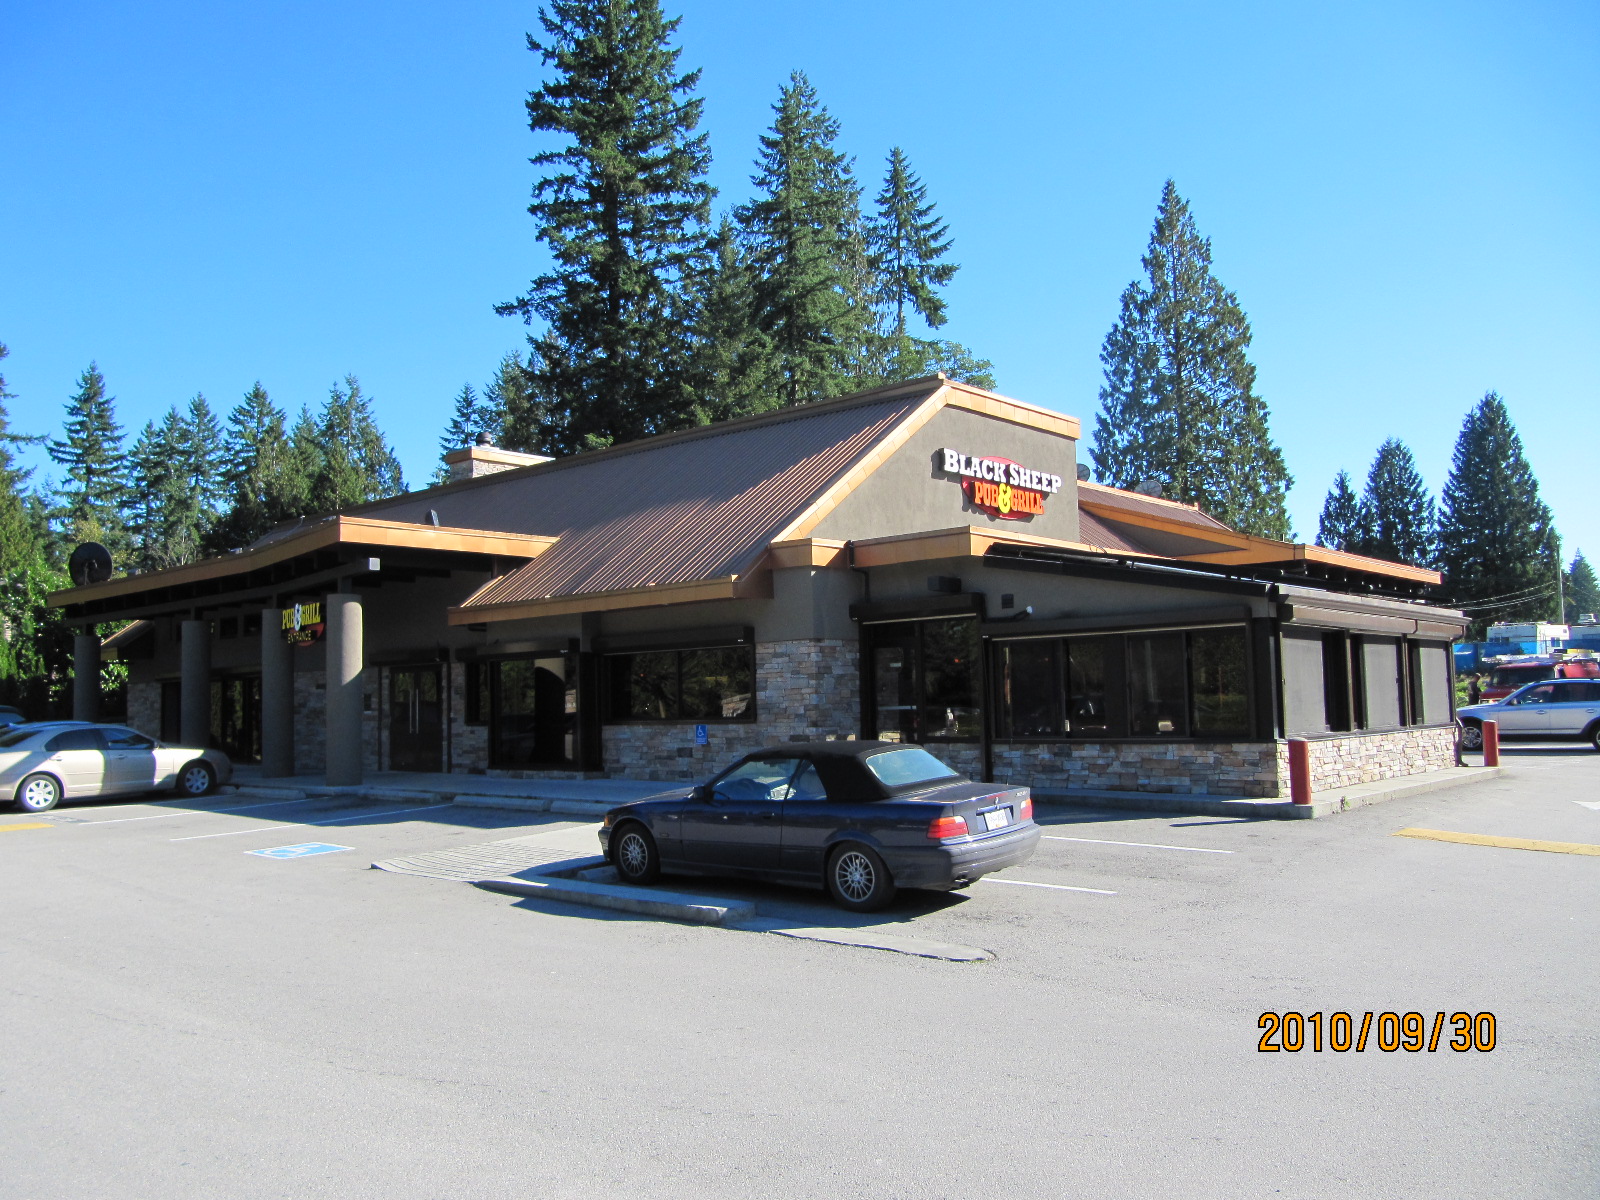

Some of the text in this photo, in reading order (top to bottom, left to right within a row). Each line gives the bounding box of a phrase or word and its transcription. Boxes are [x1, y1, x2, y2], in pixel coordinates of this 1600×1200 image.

[943, 448, 1061, 494] BLACK SHEEP
[974, 481, 999, 507] PUB
[1010, 488, 1044, 515] GRILL
[282, 608, 295, 629] PUB
[301, 602, 320, 626] GRILL
[287, 630, 311, 644] ENTRANCE
